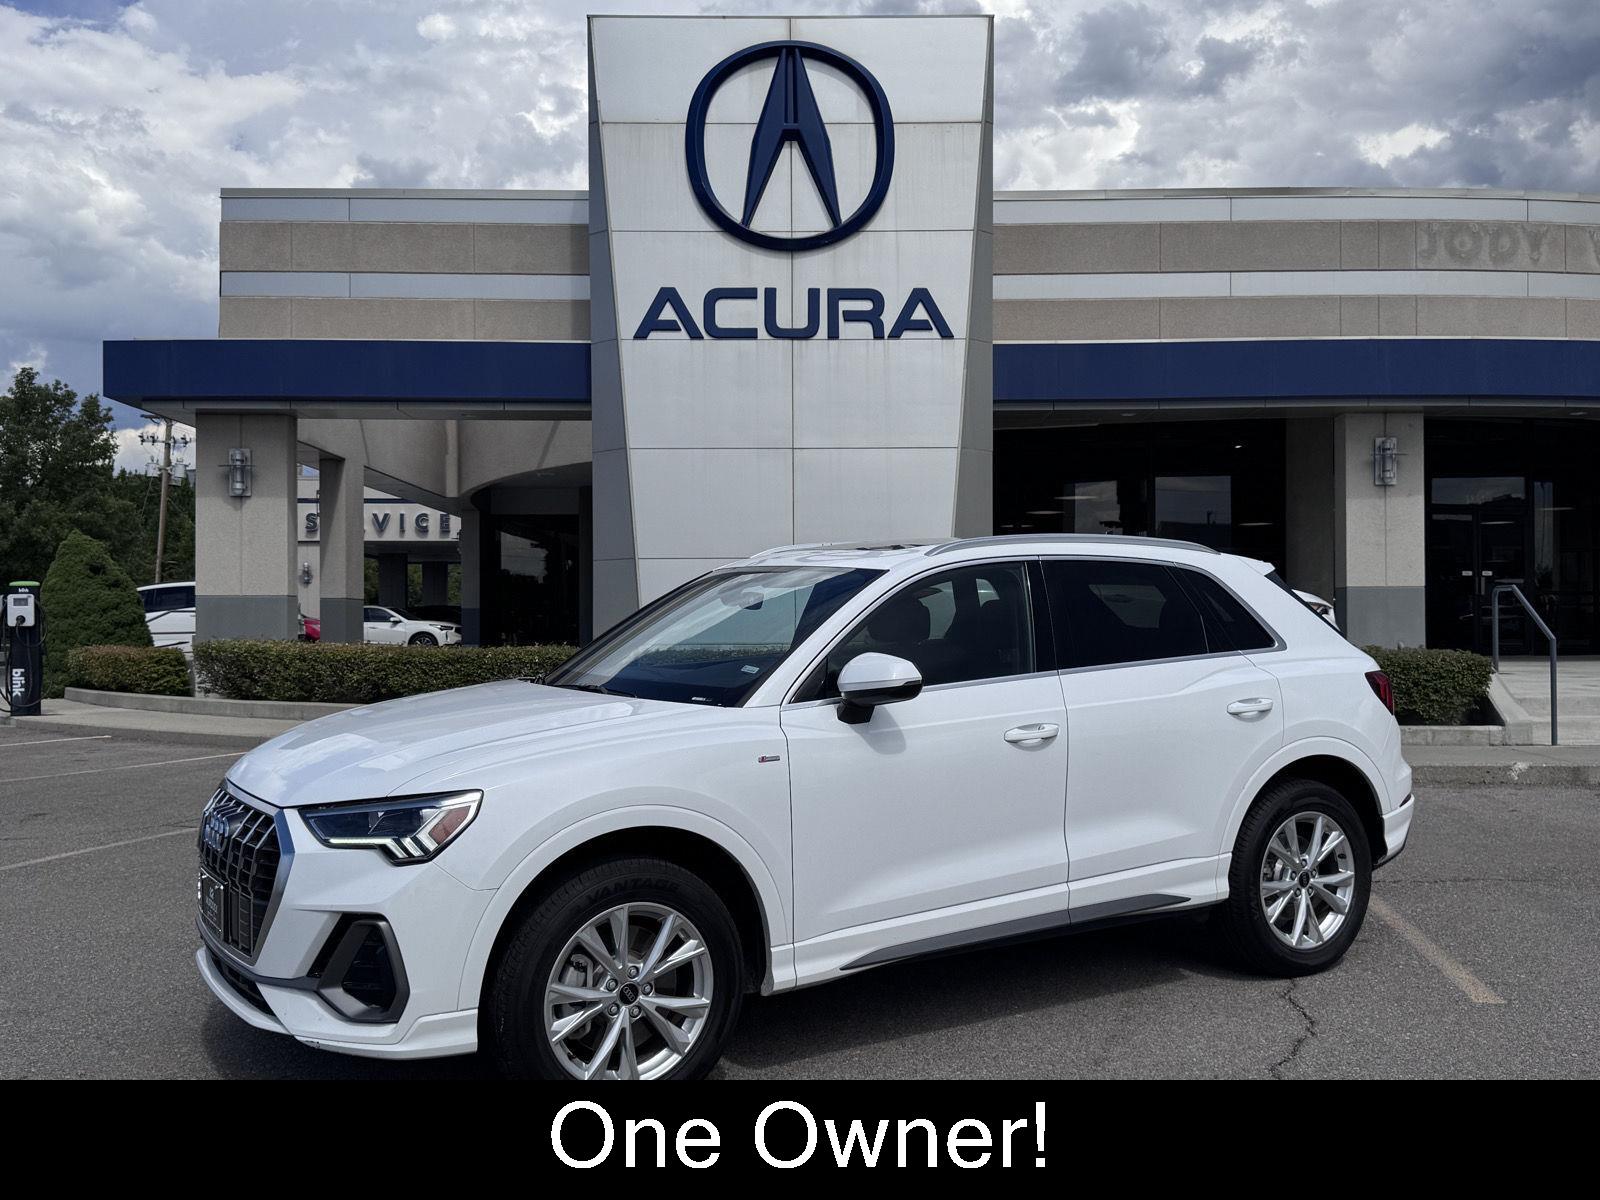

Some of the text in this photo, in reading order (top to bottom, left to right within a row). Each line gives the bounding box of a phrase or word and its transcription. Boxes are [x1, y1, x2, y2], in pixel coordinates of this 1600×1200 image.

[1418, 222, 1547, 265] JODY
[633, 287, 954, 340] ACURA
[305, 512, 451, 534] SVICE
[12, 668, 25, 697] blink
